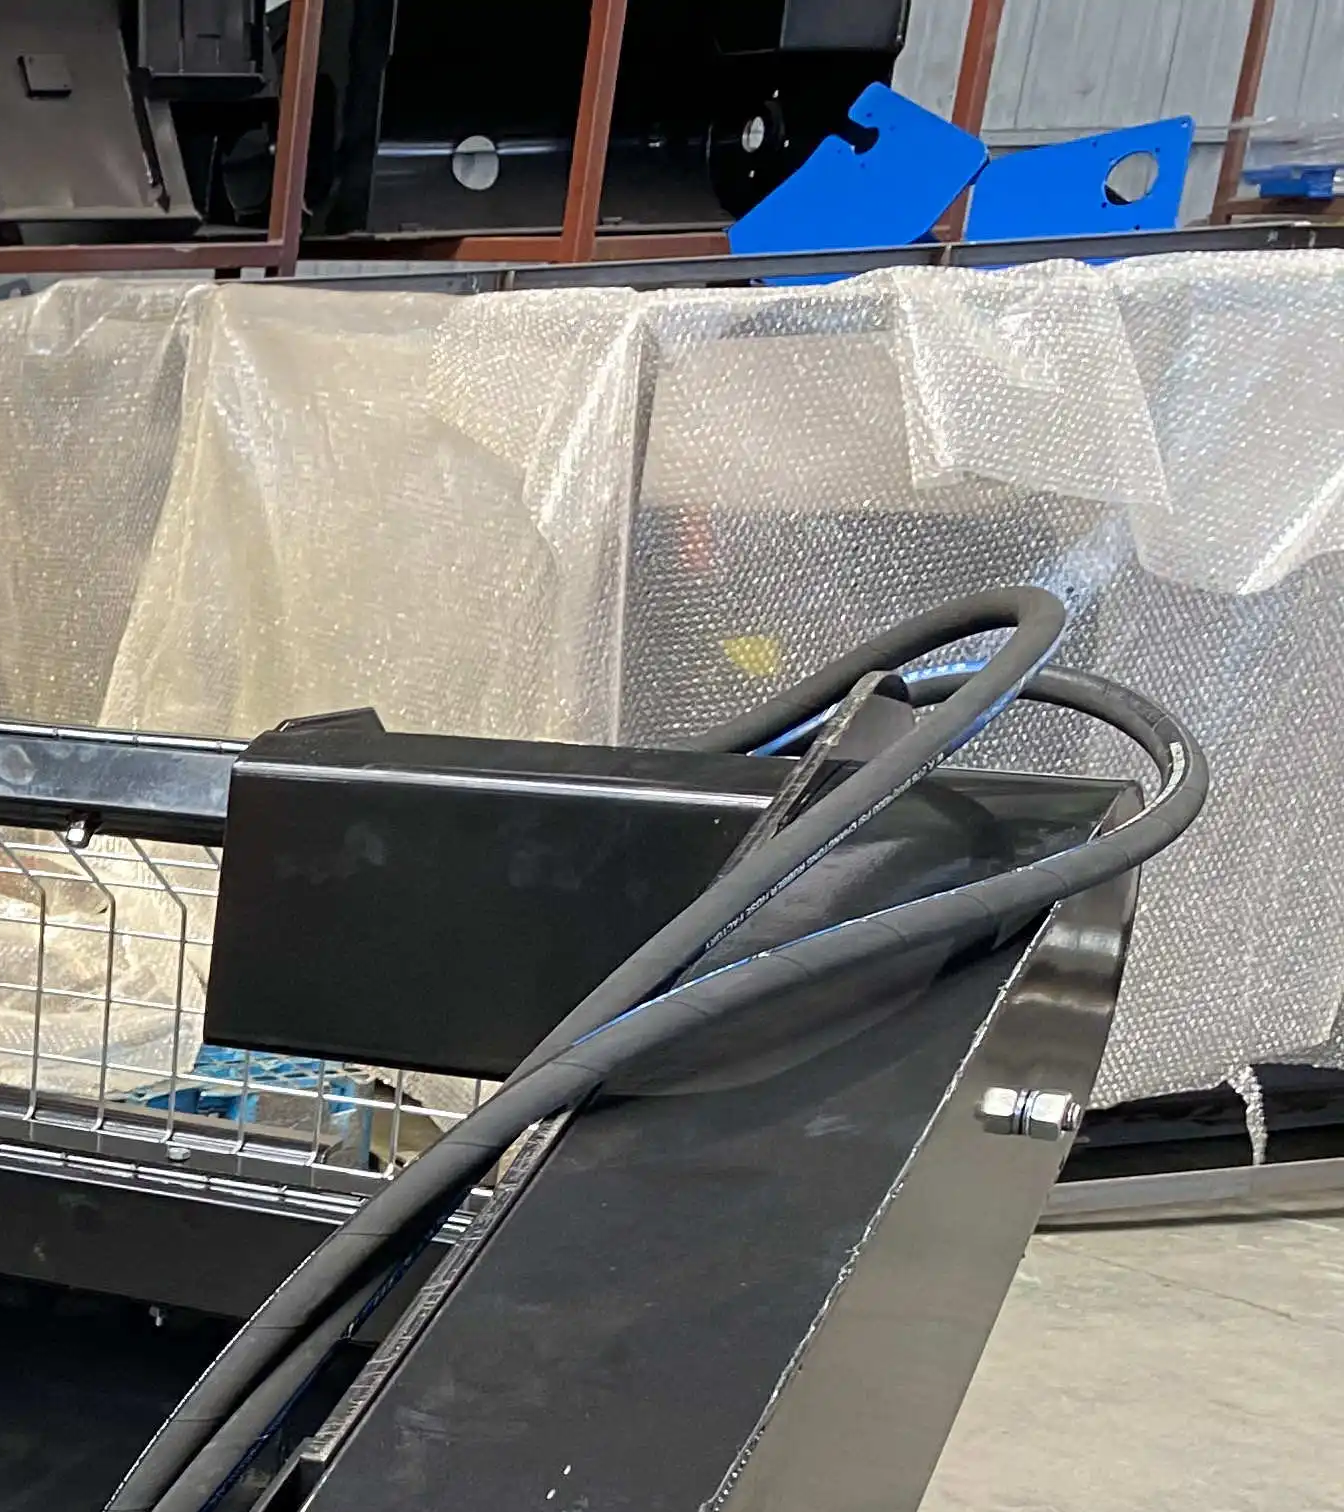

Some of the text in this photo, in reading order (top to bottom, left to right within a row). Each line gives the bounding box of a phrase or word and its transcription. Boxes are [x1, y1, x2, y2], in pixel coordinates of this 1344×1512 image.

[770, 861, 806, 897] RUBBER
[746, 891, 770, 916] HOSE
[704, 911, 745, 950] FACTORY
